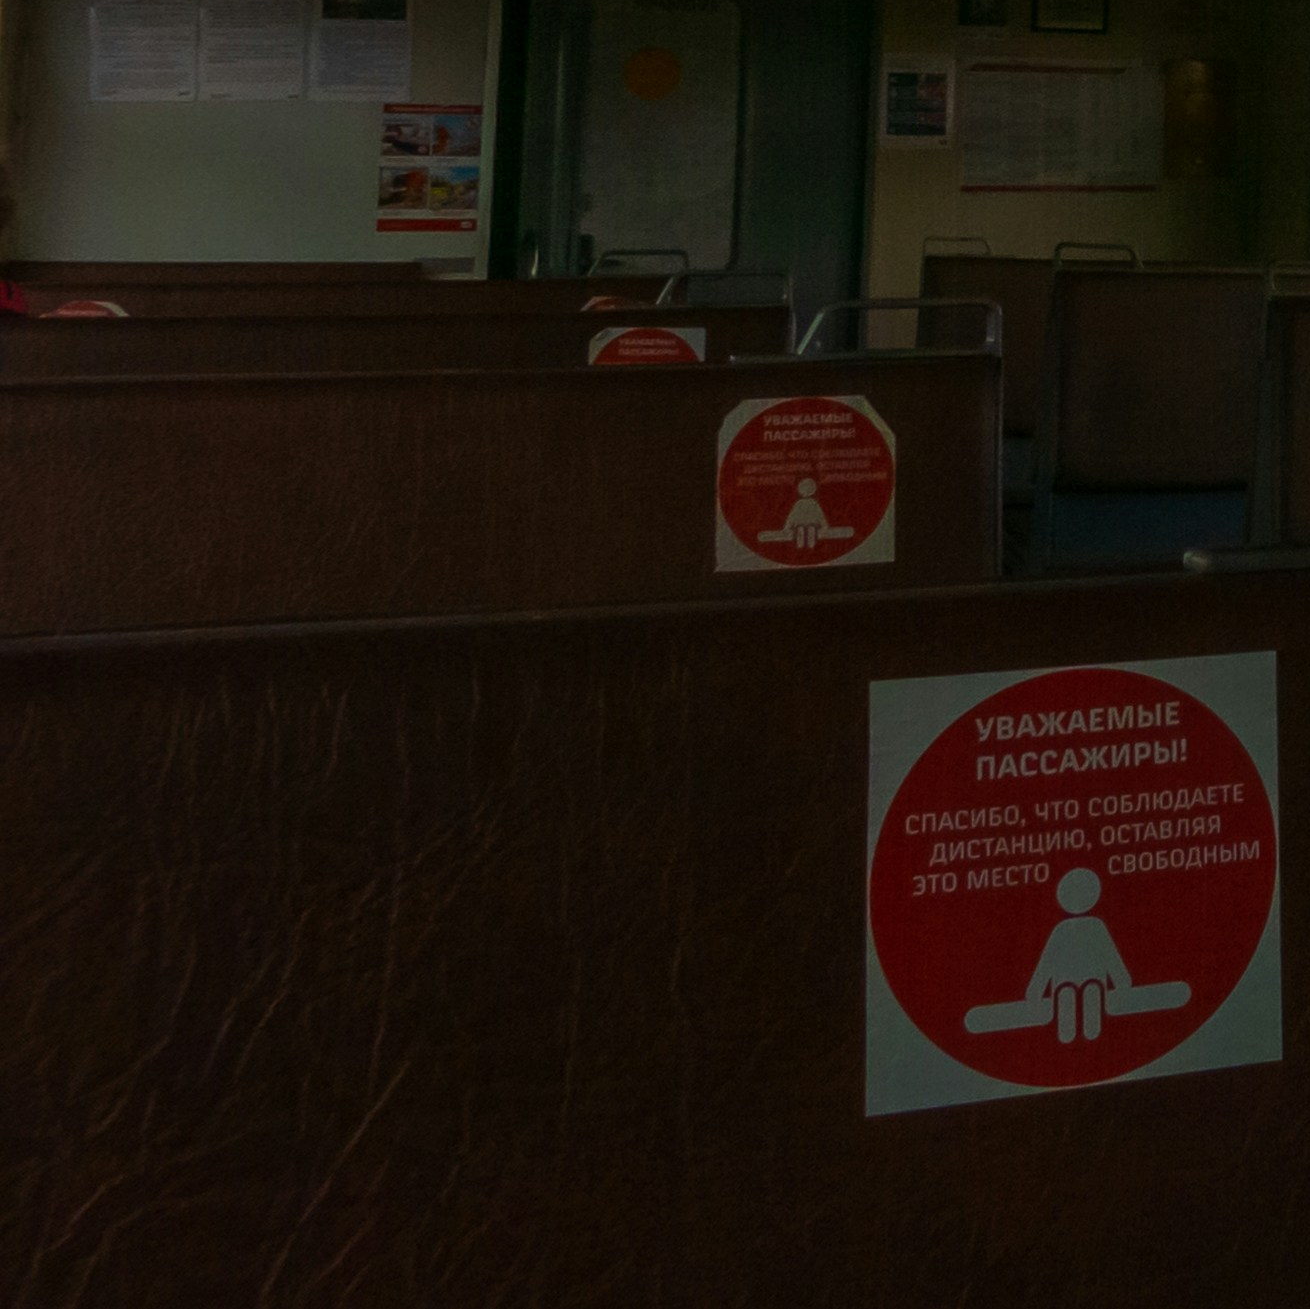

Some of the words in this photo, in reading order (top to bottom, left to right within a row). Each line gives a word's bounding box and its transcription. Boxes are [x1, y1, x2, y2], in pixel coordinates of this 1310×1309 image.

[763, 412, 854, 427] УВАЖАЕМЫЕ
[975, 701, 1181, 743] УВАЖАЕМЫЕ
[976, 738, 1188, 781] ПАССАЖИРЫ!
[905, 804, 1027, 836] СПАСИБО,
[1035, 799, 1080, 824] ЧТО
[1088, 783, 1245, 817] СОБЛЮДАЕТЕ
[929, 828, 1093, 867] ДИСТАНЦИЮ,
[1100, 814, 1222, 846] ОСТАВЛЯЯ
[912, 872, 958, 897] ЭТО
[967, 862, 1050, 891] МЕСТО
[1108, 840, 1262, 876] СВОБОДНЫМ
